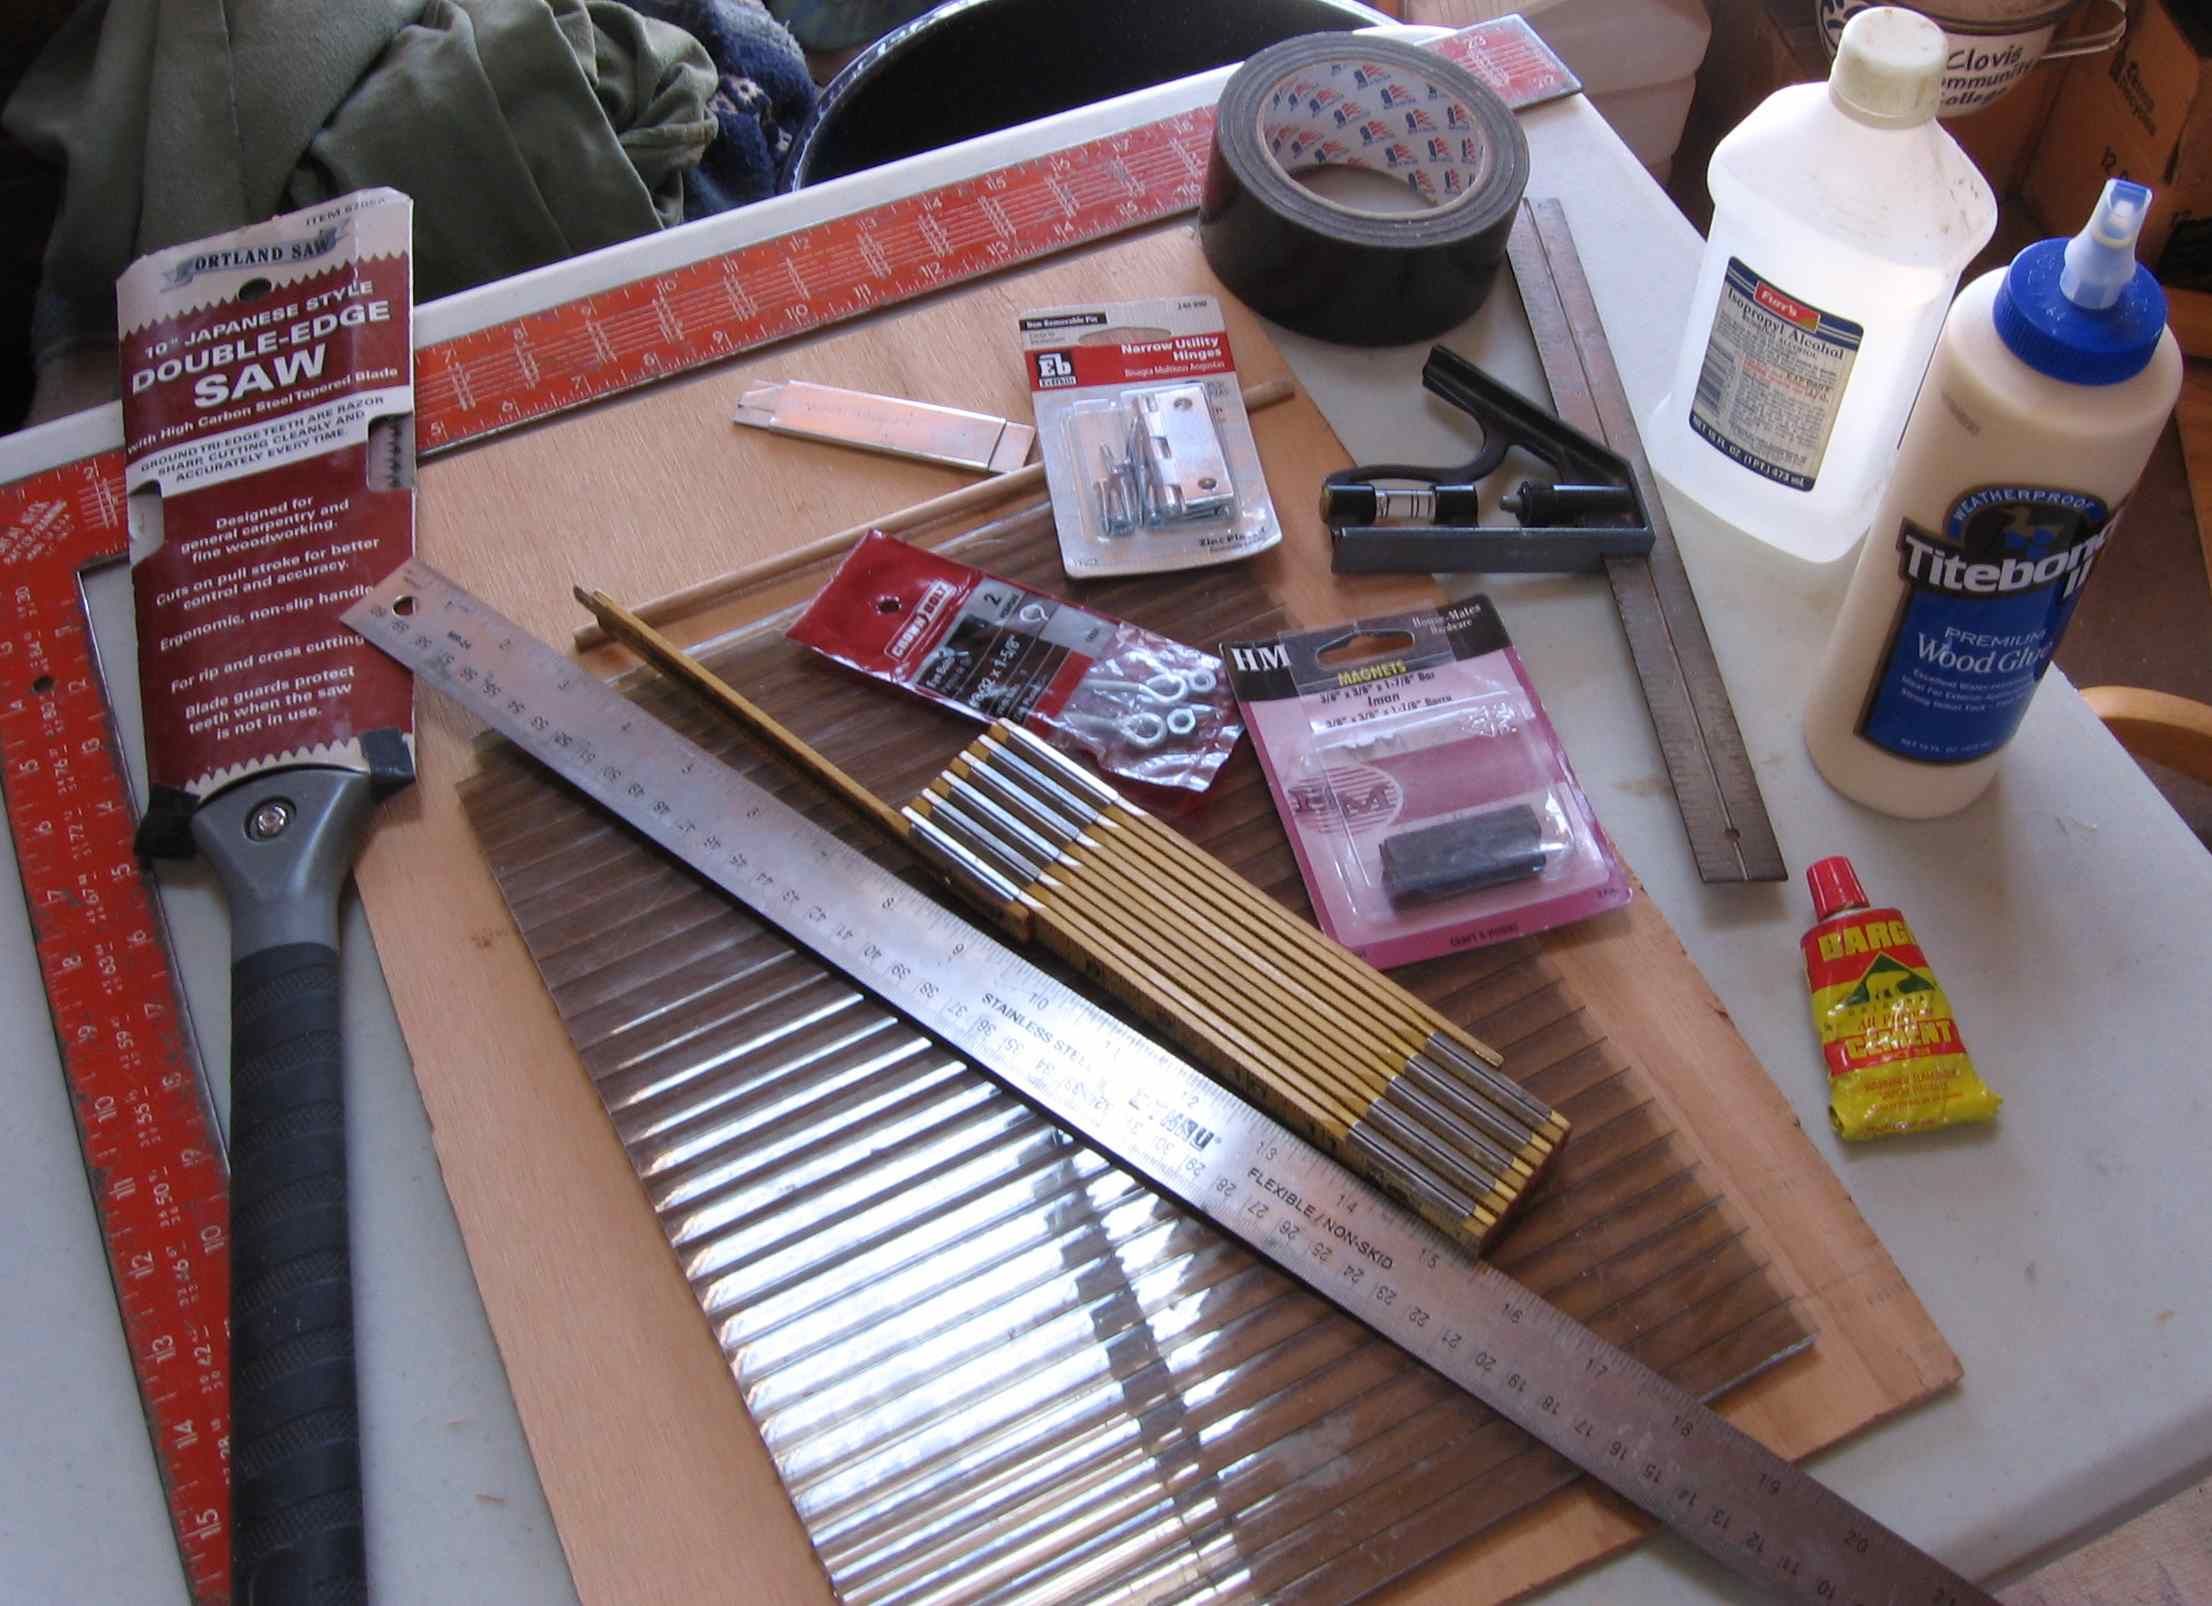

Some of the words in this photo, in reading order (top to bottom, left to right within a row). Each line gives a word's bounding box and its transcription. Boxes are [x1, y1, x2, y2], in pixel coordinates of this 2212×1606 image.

[1941, 59, 2033, 89] mmunity
[1946, 44, 2023, 71] Clovis
[1941, 86, 2008, 105] ollege
[185, 303, 298, 346] JAPANESE
[306, 280, 374, 312] STYLE
[1728, 287, 1785, 334] Isopropyl
[1790, 329, 1844, 360] Alcohol
[132, 300, 391, 395] DOUBLE-EDGE
[1121, 341, 1173, 354] Narrow
[1175, 336, 1218, 349] Utility
[1173, 348, 1222, 361] Hinges
[194, 344, 327, 408] SAW
[128, 433, 156, 455] with
[161, 420, 195, 440] High
[198, 407, 251, 428] Carbon
[256, 394, 293, 413] Steel
[295, 375, 351, 401] Tapered
[355, 366, 398, 384] Blade
[141, 446, 198, 473] GROUND
[263, 418, 303, 438] TEETH
[307, 408, 335, 424] ARE
[336, 396, 385, 416] RAZOR
[176, 452, 263, 482] ACCURATELY
[267, 439, 311, 462] EVERY
[312, 429, 345, 447] TIME
[209, 439, 268, 462] CUTTING
[273, 421, 334, 446] CLEANLY
[336, 410, 366, 427] AND
[180, 529, 239, 556] general
[242, 508, 316, 538] carpentry
[320, 499, 350, 517] and
[216, 503, 288, 529] Designed
[292, 496, 314, 512] for
[1953, 488, 2097, 522] WEATHERPROOF
[193, 546, 221, 565] fine
[226, 521, 338, 556] woodworking.
[155, 586, 190, 607] Cuts
[193, 578, 213, 594] on
[217, 567, 248, 589] pull
[251, 554, 301, 577] stroke
[304, 548, 326, 565] for
[331, 537, 381, 558] better
[183, 586, 239, 611] control
[242, 575, 273, 594] and
[276, 559, 350, 586] accuracy.
[159, 614, 246, 652] Ergonomic,
[249, 595, 315, 623] non-slip
[923, 584, 947, 614] BOLT
[984, 593, 1001, 606] 2
[1231, 644, 1290, 673] HM
[1918, 632, 1997, 673] Wood
[1944, 626, 2047, 648] PREMIUM
[171, 677, 194, 694] For
[199, 665, 220, 686] rip
[224, 655, 254, 676] and
[258, 644, 302, 664] cross
[185, 697, 229, 720] Blade
[233, 681, 290, 706] guards
[294, 665, 356, 691] protect
[1338, 660, 1408, 687] MAGNETS
[1417, 671, 1436, 682] Bar
[189, 712, 230, 735] teeth
[234, 700, 281, 719] when
[284, 691, 313, 709] the
[317, 681, 352, 698] saw
[216, 728, 230, 741] is
[234, 718, 263, 737] not
[266, 712, 283, 727] in
[287, 706, 323, 721] use.
[981, 992, 1053, 1043] STAINLESS
[1054, 1039, 1092, 1072] STE
[1247, 1167, 1314, 1218] FLEXIBLE
[1326, 1217, 1393, 1271] NON-SKID
